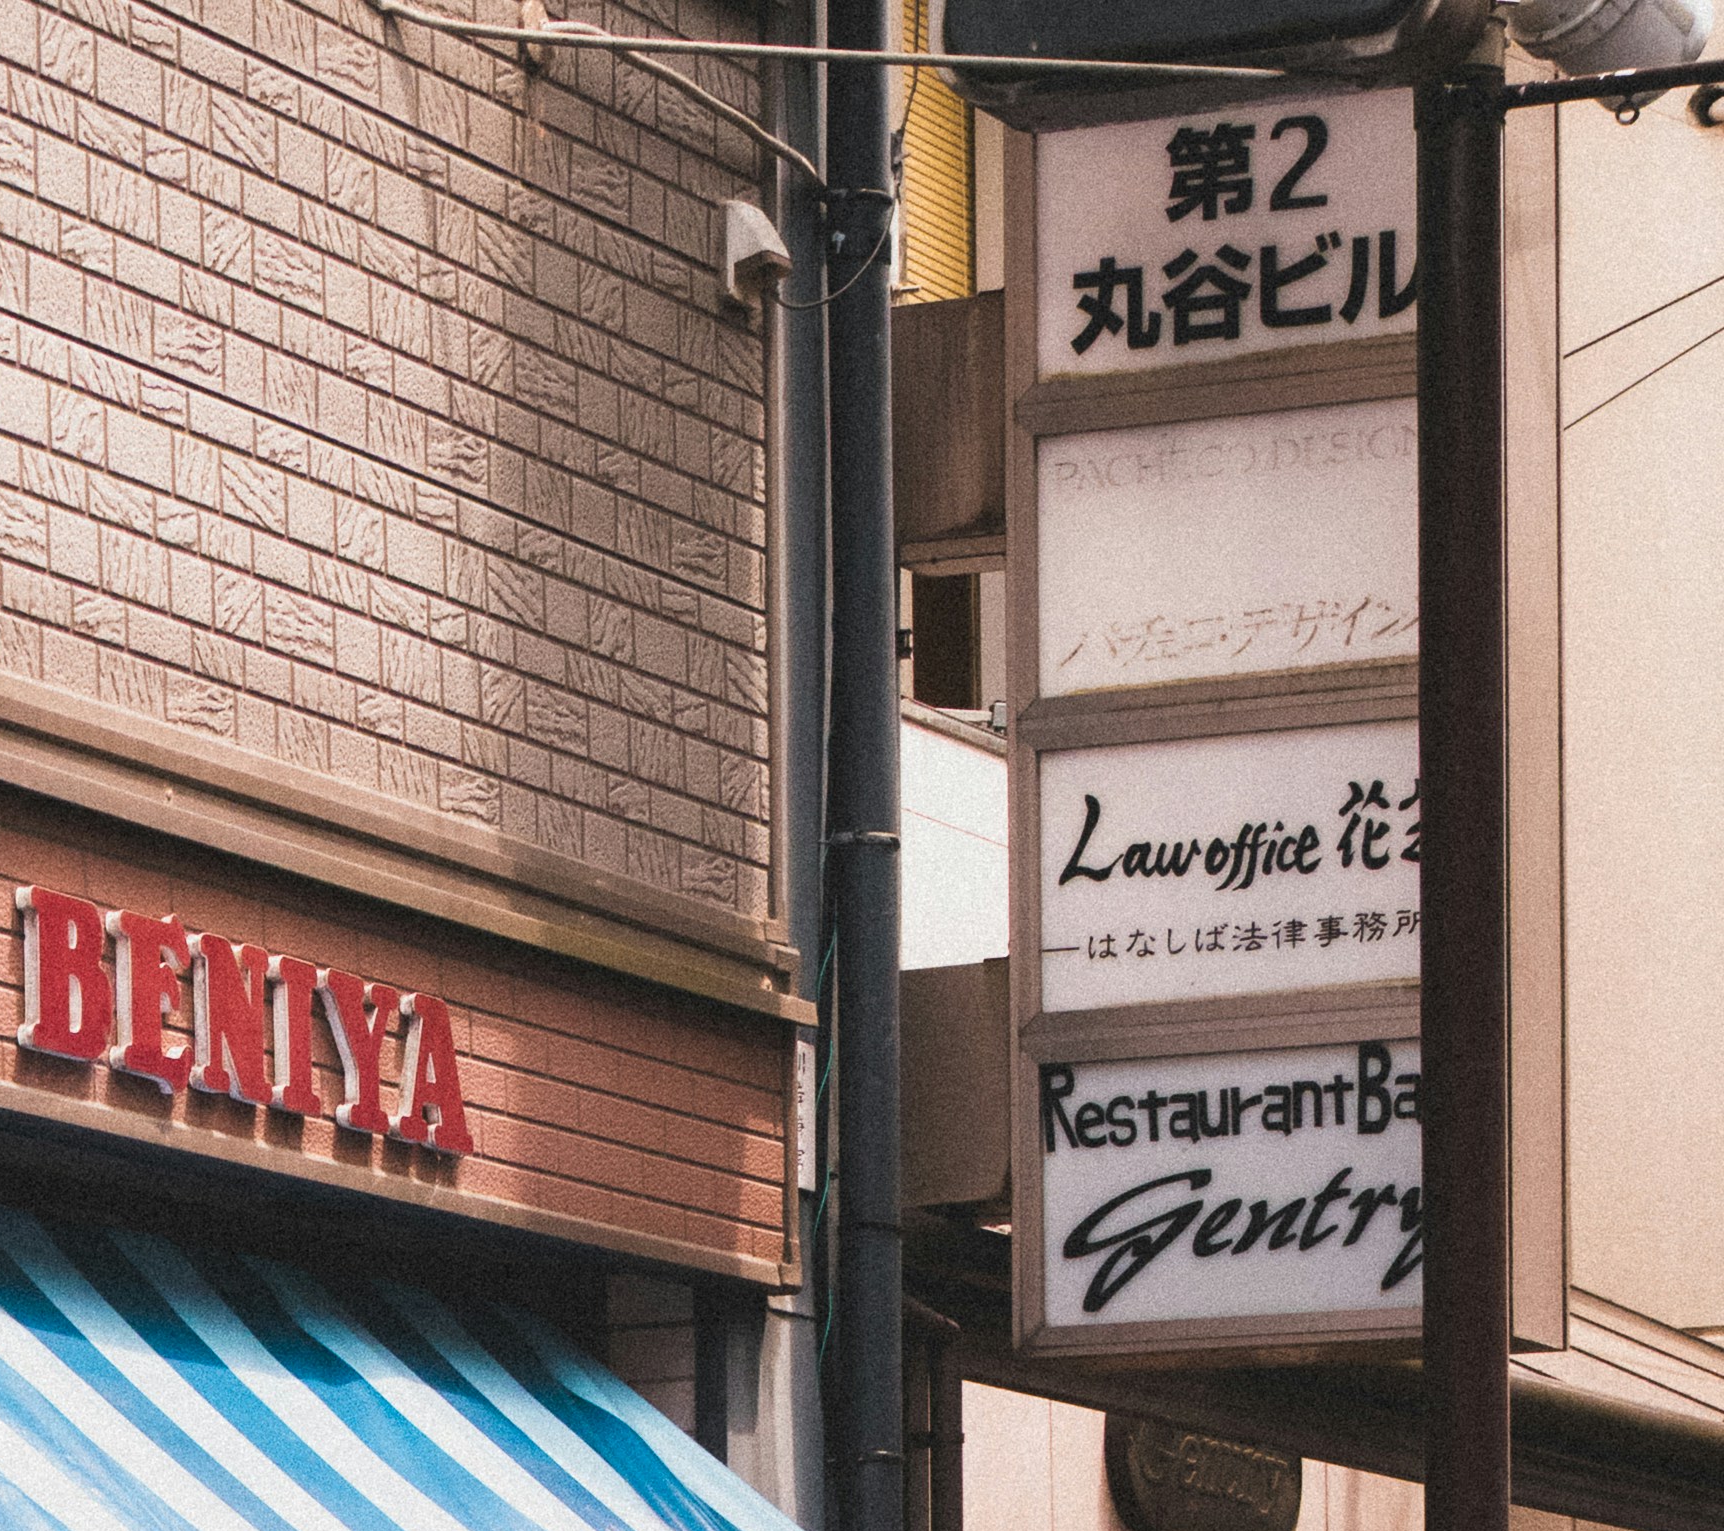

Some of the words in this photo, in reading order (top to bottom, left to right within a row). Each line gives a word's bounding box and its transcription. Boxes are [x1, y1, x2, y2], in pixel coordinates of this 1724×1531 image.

[1165, 115, 1329, 222] 第2
[1070, 230, 1418, 355] 丸谷ビル
[14, 884, 473, 1155] BENIYA
[1040, 1062, 1354, 1155] Restaurant
[1063, 1167, 1423, 1314] Gentry
